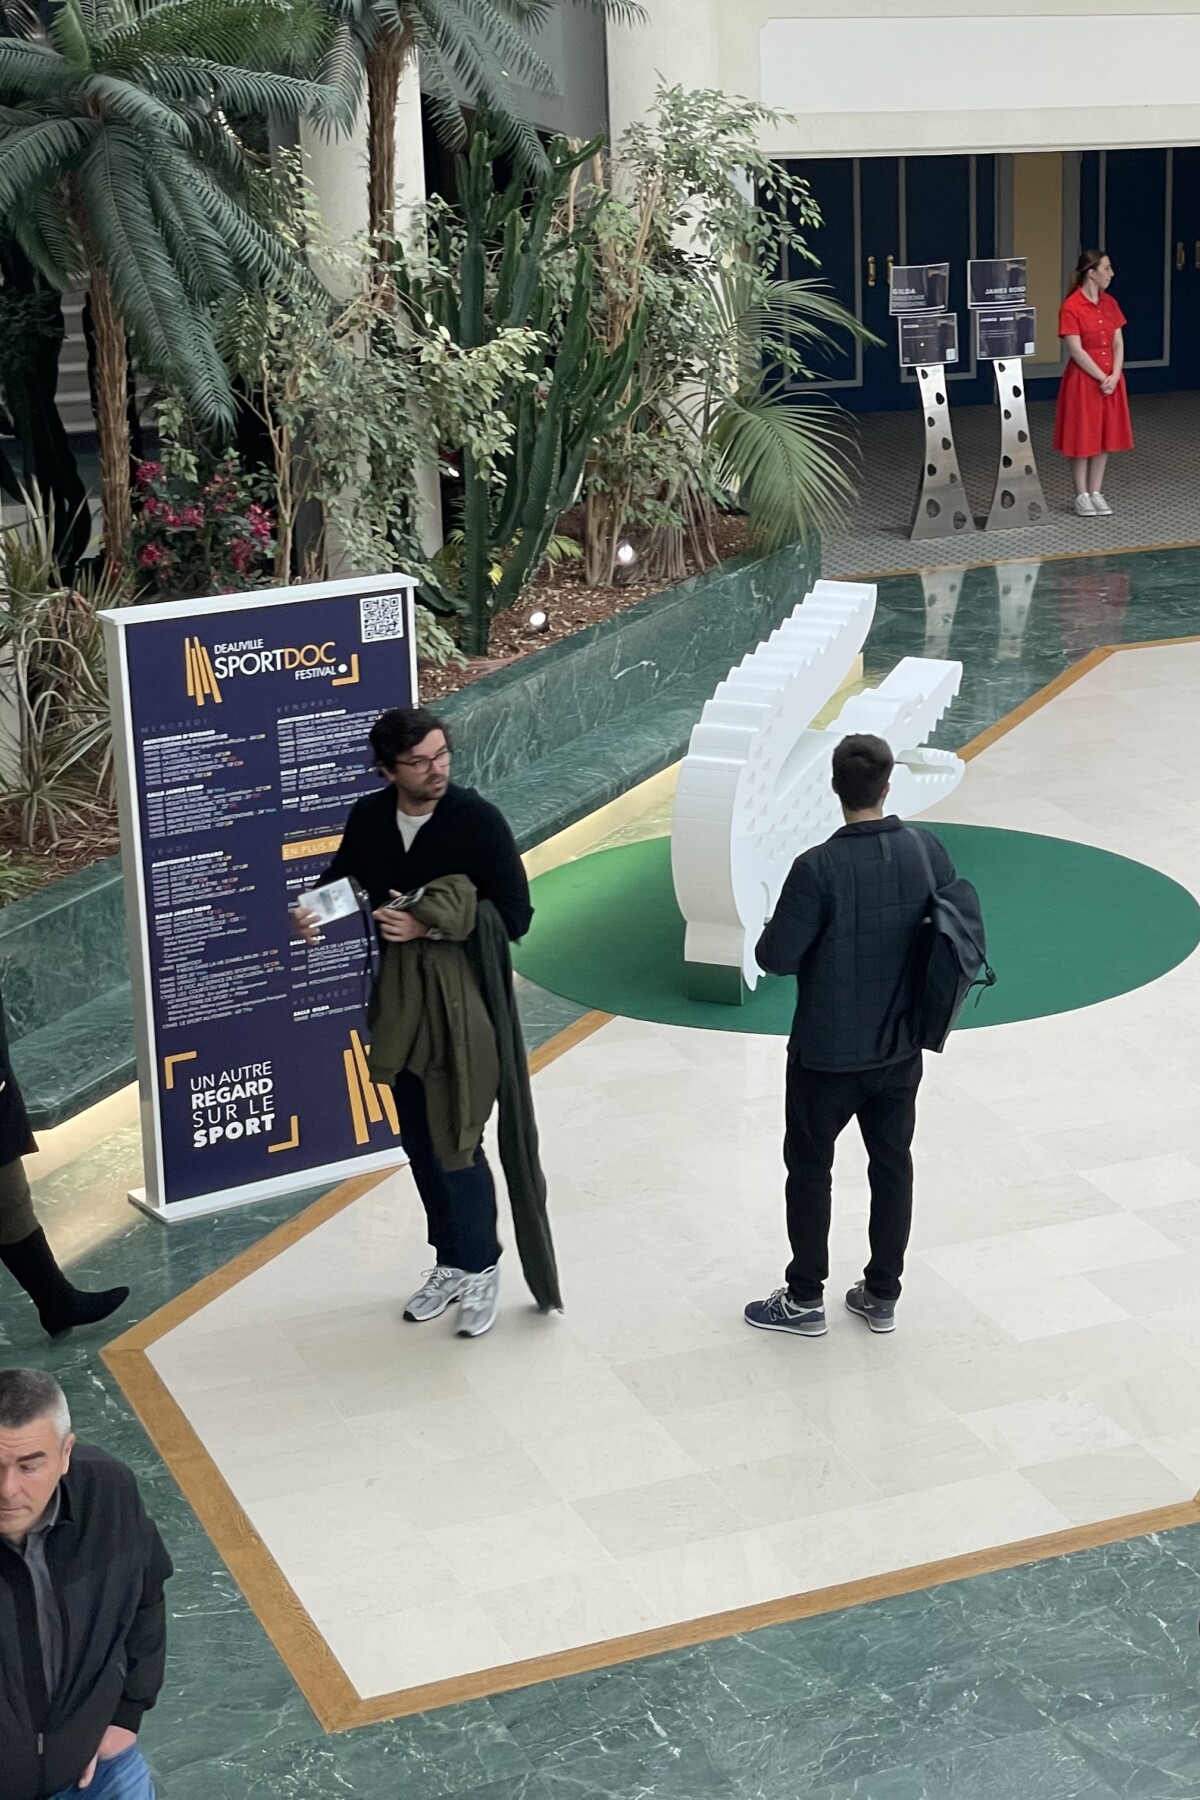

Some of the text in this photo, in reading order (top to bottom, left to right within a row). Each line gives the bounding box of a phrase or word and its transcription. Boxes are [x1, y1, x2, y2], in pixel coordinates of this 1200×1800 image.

[893, 287, 916, 296] GILDA
[214, 639, 263, 653] DEAUVILLE
[214, 642, 336, 680] SPORTDOC
[295, 666, 336, 680] FESTIVAL
[285, 847, 298, 857] EN
[301, 842, 325, 854] PLUS
[191, 1062, 272, 1091] UN AUTRE
[191, 1079, 273, 1108] REGARD
[192, 1095, 274, 1128] SUR LE
[193, 1114, 275, 1148] SPORT
